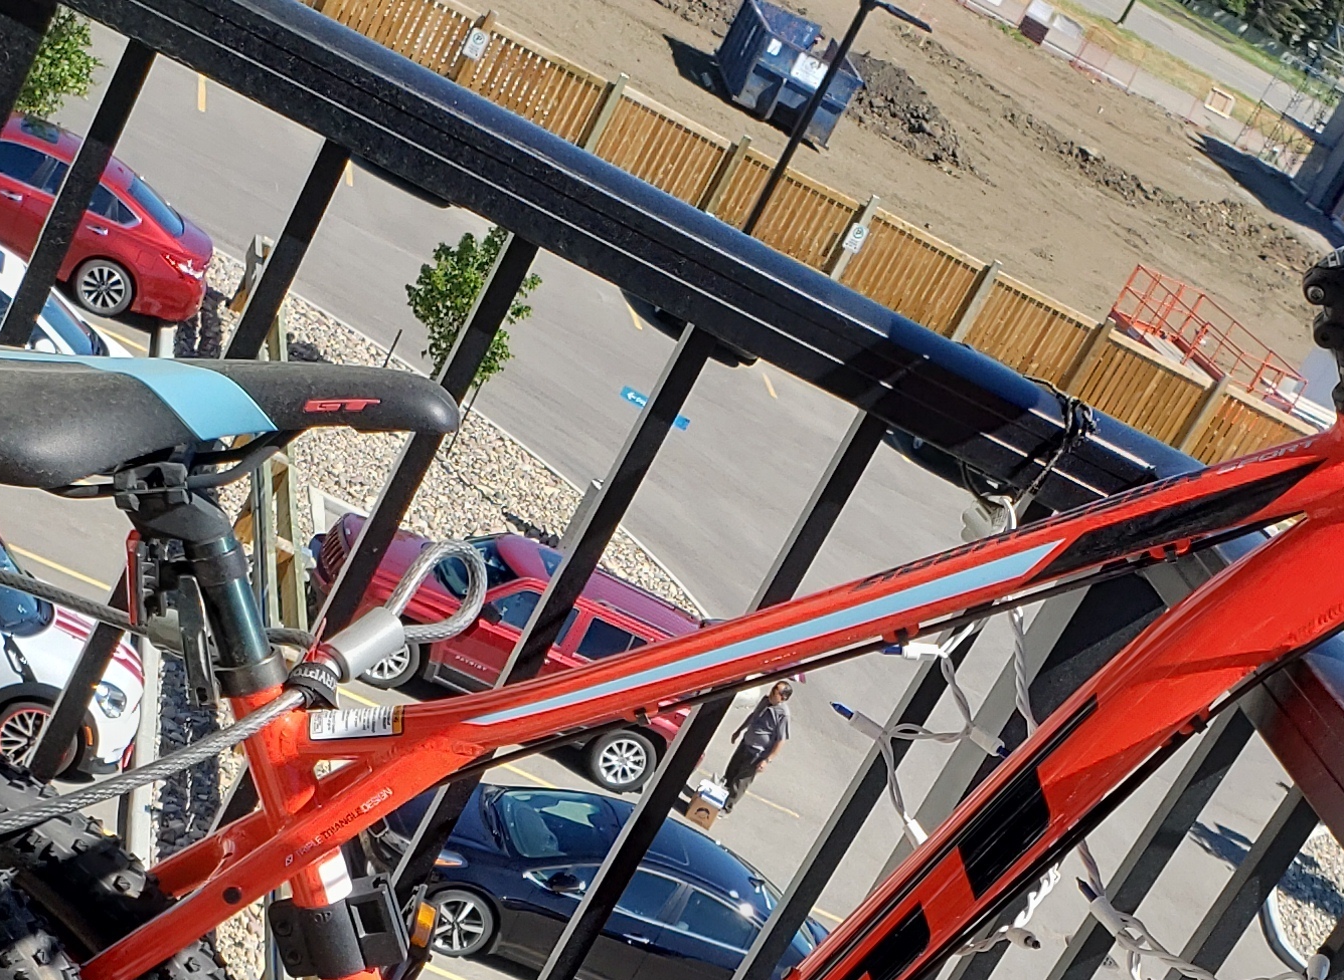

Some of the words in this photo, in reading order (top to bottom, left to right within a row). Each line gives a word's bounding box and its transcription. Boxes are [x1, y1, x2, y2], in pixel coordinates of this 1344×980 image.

[304, 398, 380, 413] GT
[320, 808, 365, 840] TRIANGLE
[360, 786, 394, 814] DESIGN
